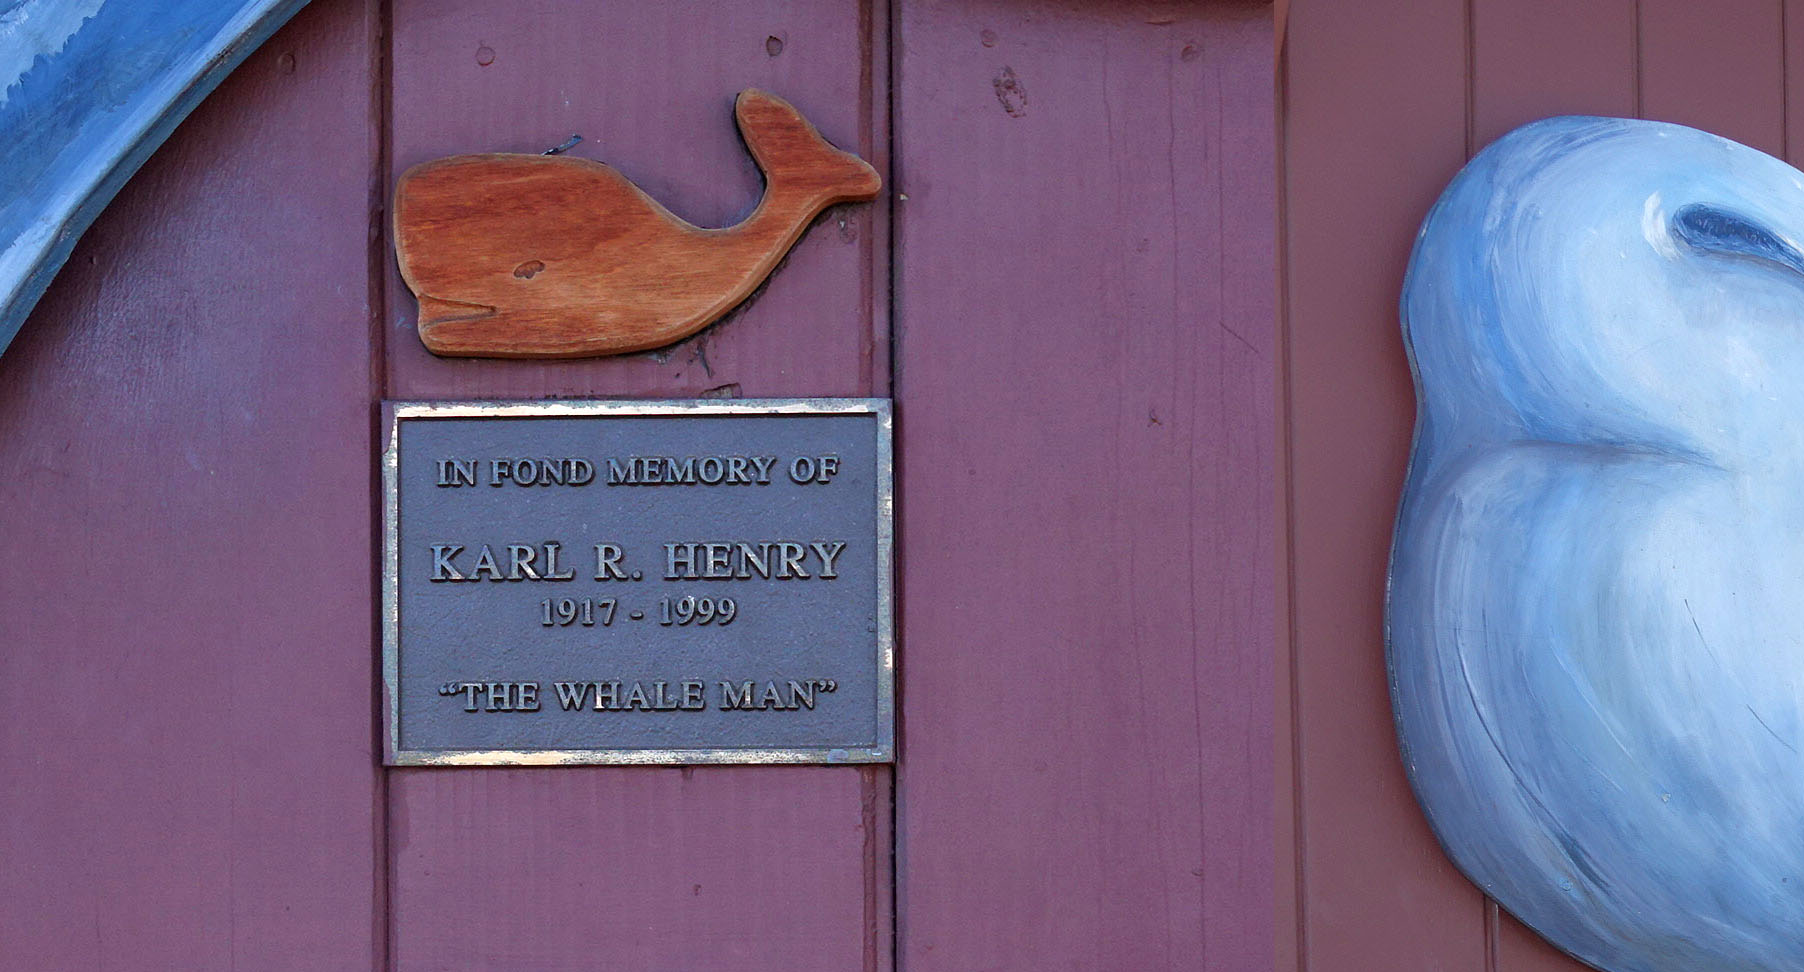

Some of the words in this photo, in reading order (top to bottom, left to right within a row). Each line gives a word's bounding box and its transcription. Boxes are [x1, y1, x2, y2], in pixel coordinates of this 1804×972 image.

[437, 458, 475, 487] IN
[490, 458, 594, 486] FOND
[607, 456, 776, 485] MEMORY
[790, 454, 839, 483] OF
[430, 541, 574, 582] KARL
[594, 543, 642, 581] R.
[664, 542, 847, 580] HENRY
[540, 598, 617, 626] 1917
[660, 595, 736, 626] 1999
[555, 680, 705, 712] WHALE
